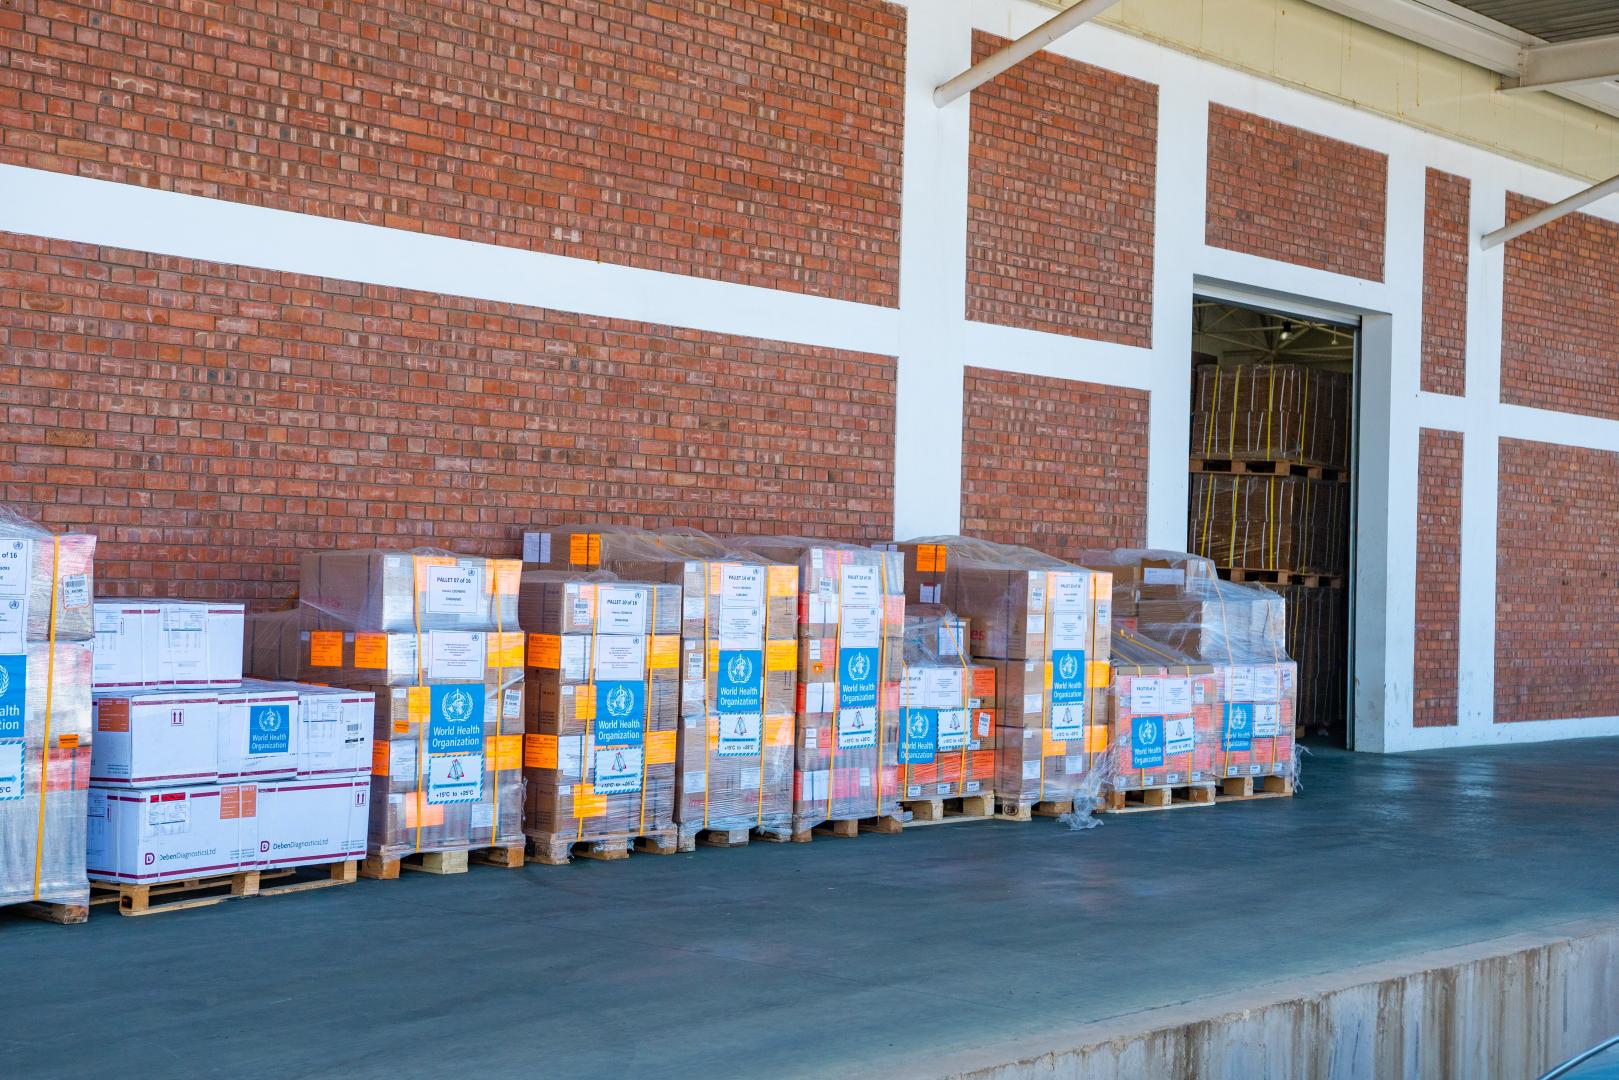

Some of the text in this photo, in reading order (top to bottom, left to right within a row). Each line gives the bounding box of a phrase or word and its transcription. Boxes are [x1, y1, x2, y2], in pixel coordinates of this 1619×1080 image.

[720, 686, 758, 696] World Health
[842, 682, 875, 693] World Health
[1053, 681, 1067, 690] World
[842, 693, 875, 704] Organization
[1053, 691, 1082, 701] Organization
[720, 697, 758, 708] Organization
[0, 704, 20, 717] alth
[0, 718, 19, 730] ion
[597, 719, 640, 730] World Health
[433, 724, 480, 736] World Health
[252, 731, 287, 742] World Health
[598, 730, 640, 743] Organization
[251, 742, 287, 751] Organization
[432, 736, 480, 750] Organization
[917, 741, 934, 750] Health
[900, 751, 933, 760] Oganization
[1134, 745, 1162, 756] World Health
[1134, 756, 1162, 766] Organization
